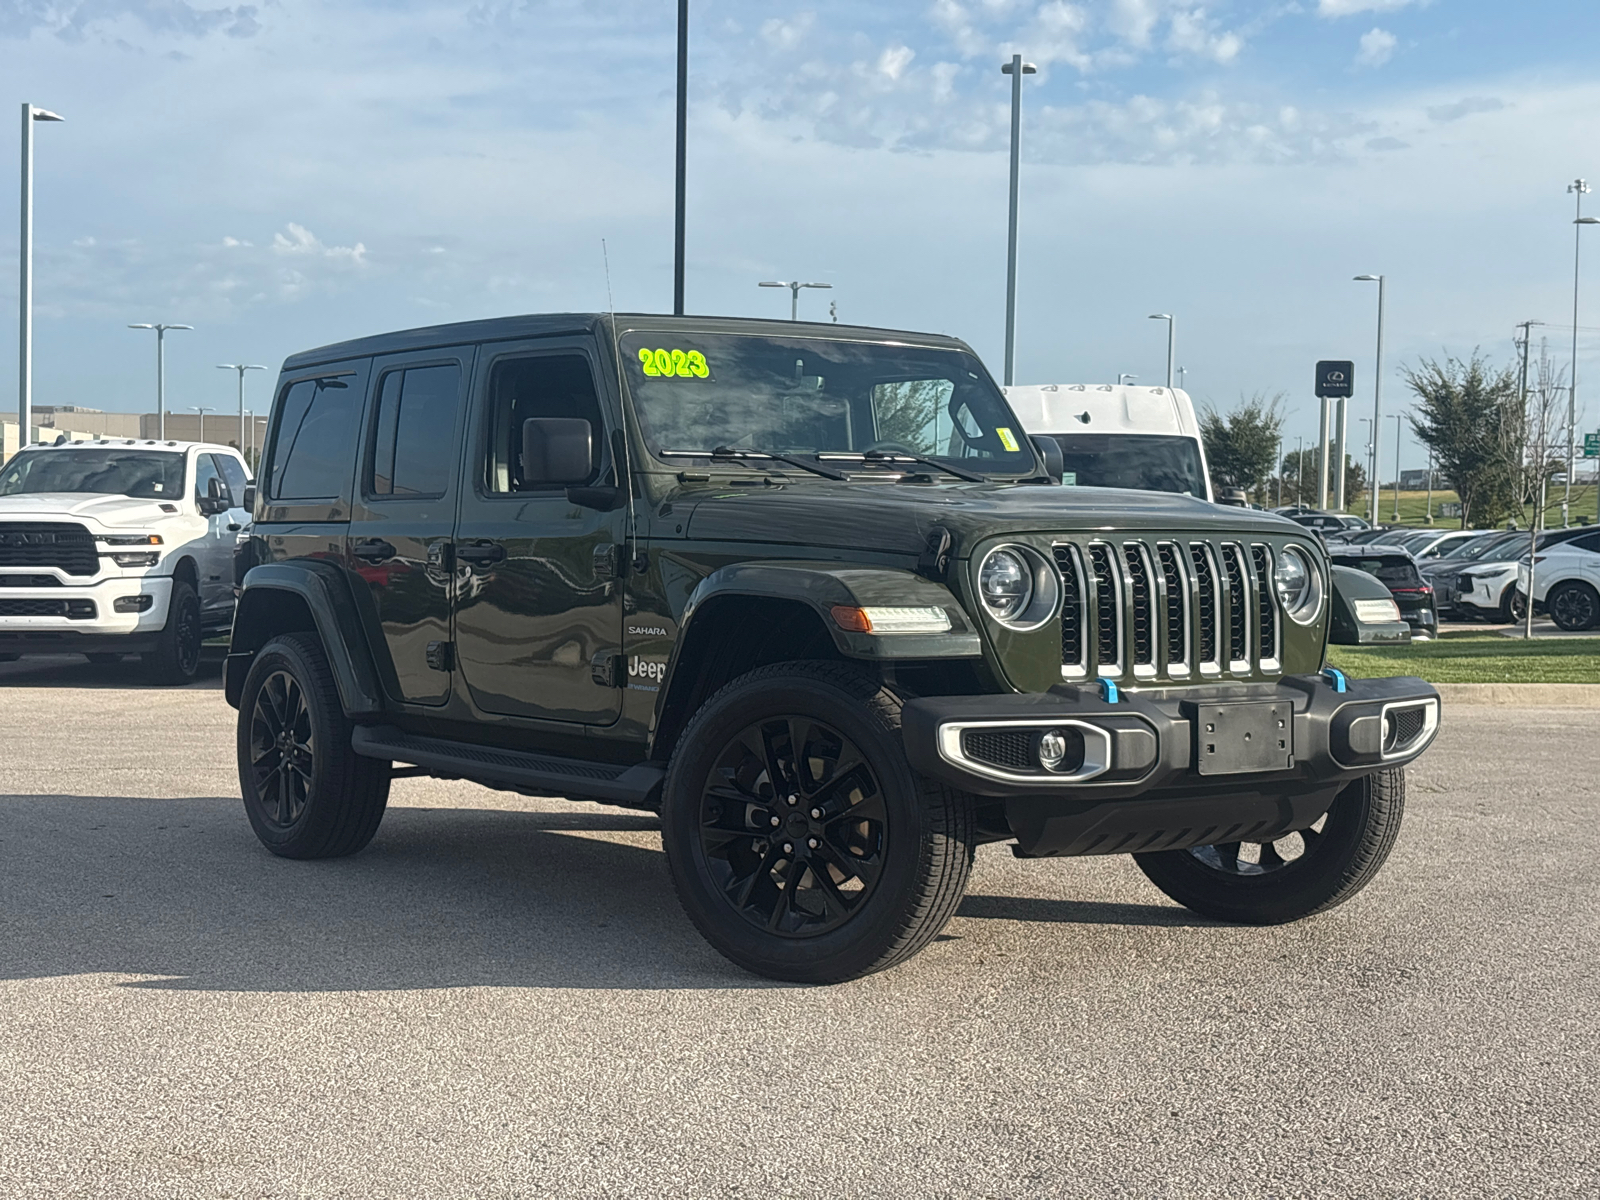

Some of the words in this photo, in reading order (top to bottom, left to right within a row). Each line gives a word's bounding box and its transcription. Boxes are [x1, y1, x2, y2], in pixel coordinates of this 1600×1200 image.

[638, 347, 710, 379] 2023
[628, 626, 667, 636] SAHARA
[628, 655, 666, 683] Jeep
